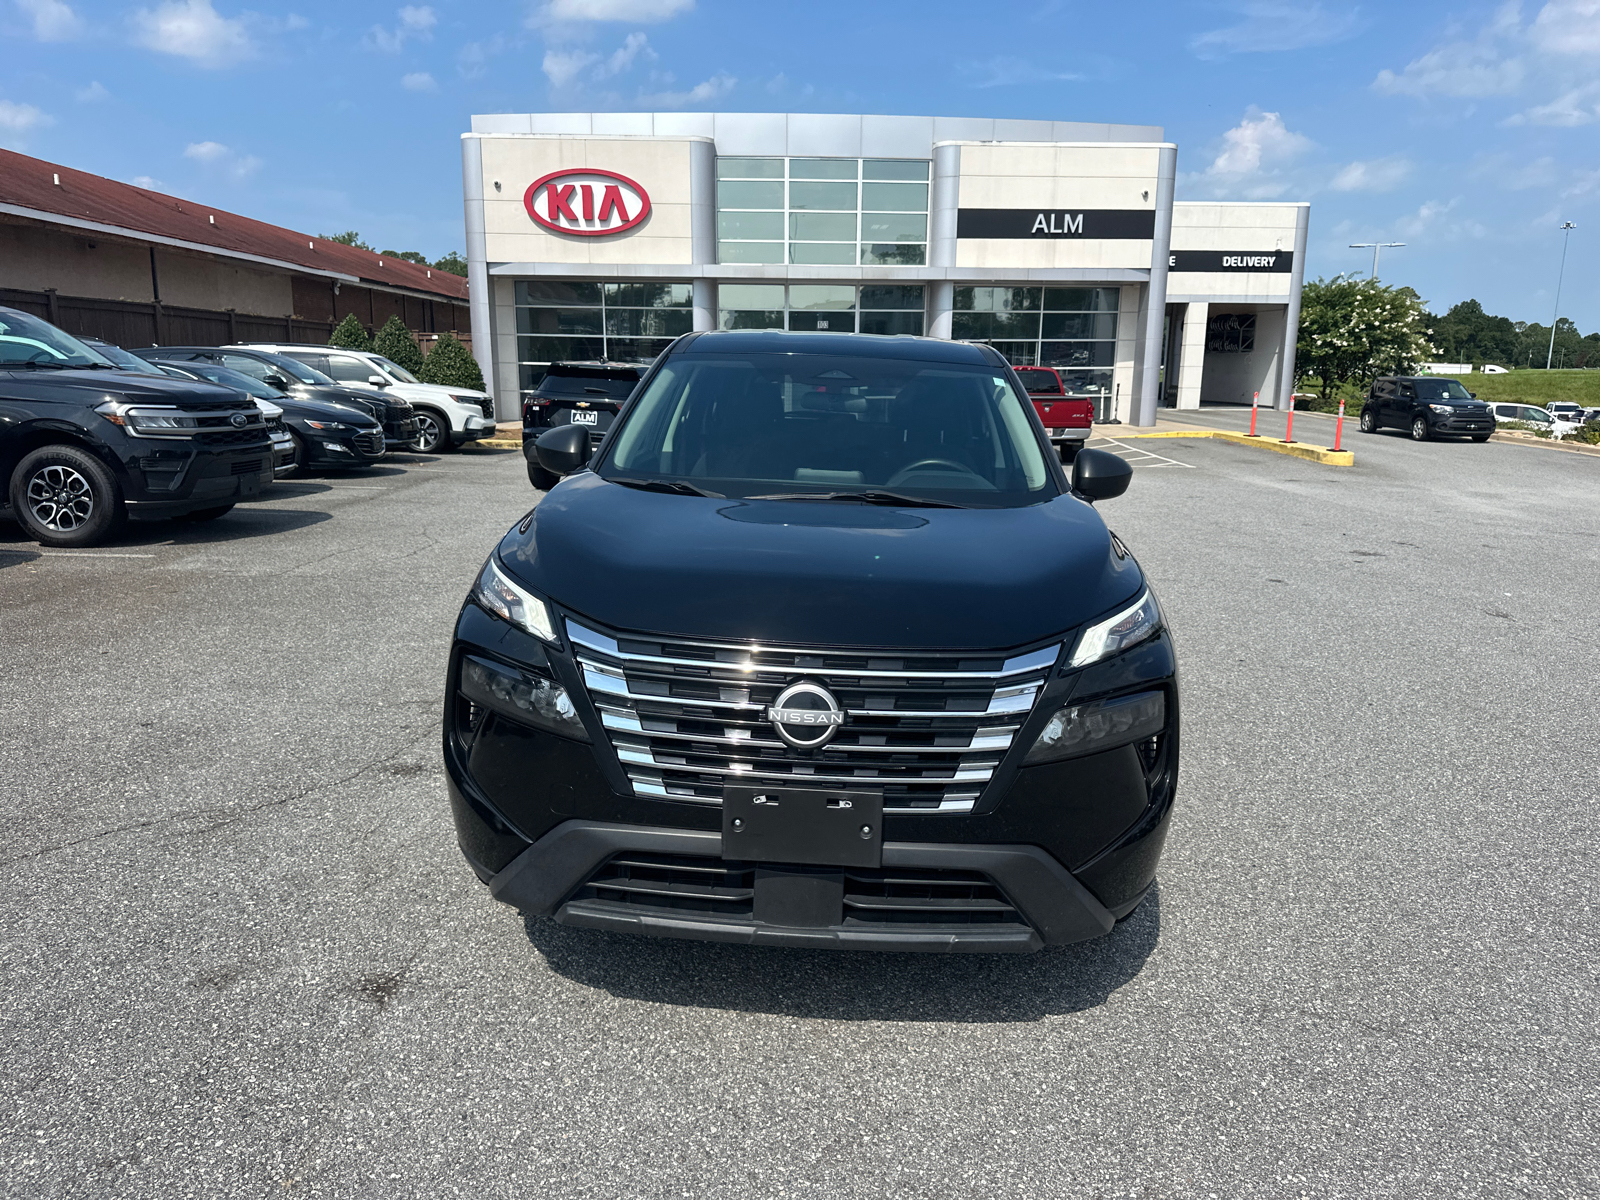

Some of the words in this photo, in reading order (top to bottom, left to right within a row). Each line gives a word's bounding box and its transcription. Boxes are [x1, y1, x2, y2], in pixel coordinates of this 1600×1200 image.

[545, 184, 630, 221] KIA
[1031, 213, 1084, 234] ALM
[1222, 256, 1276, 267] DELIVERY
[574, 413, 595, 422] ALM
[41, 452, 87, 469] VELOCITY
[769, 710, 843, 724] NISSAN
